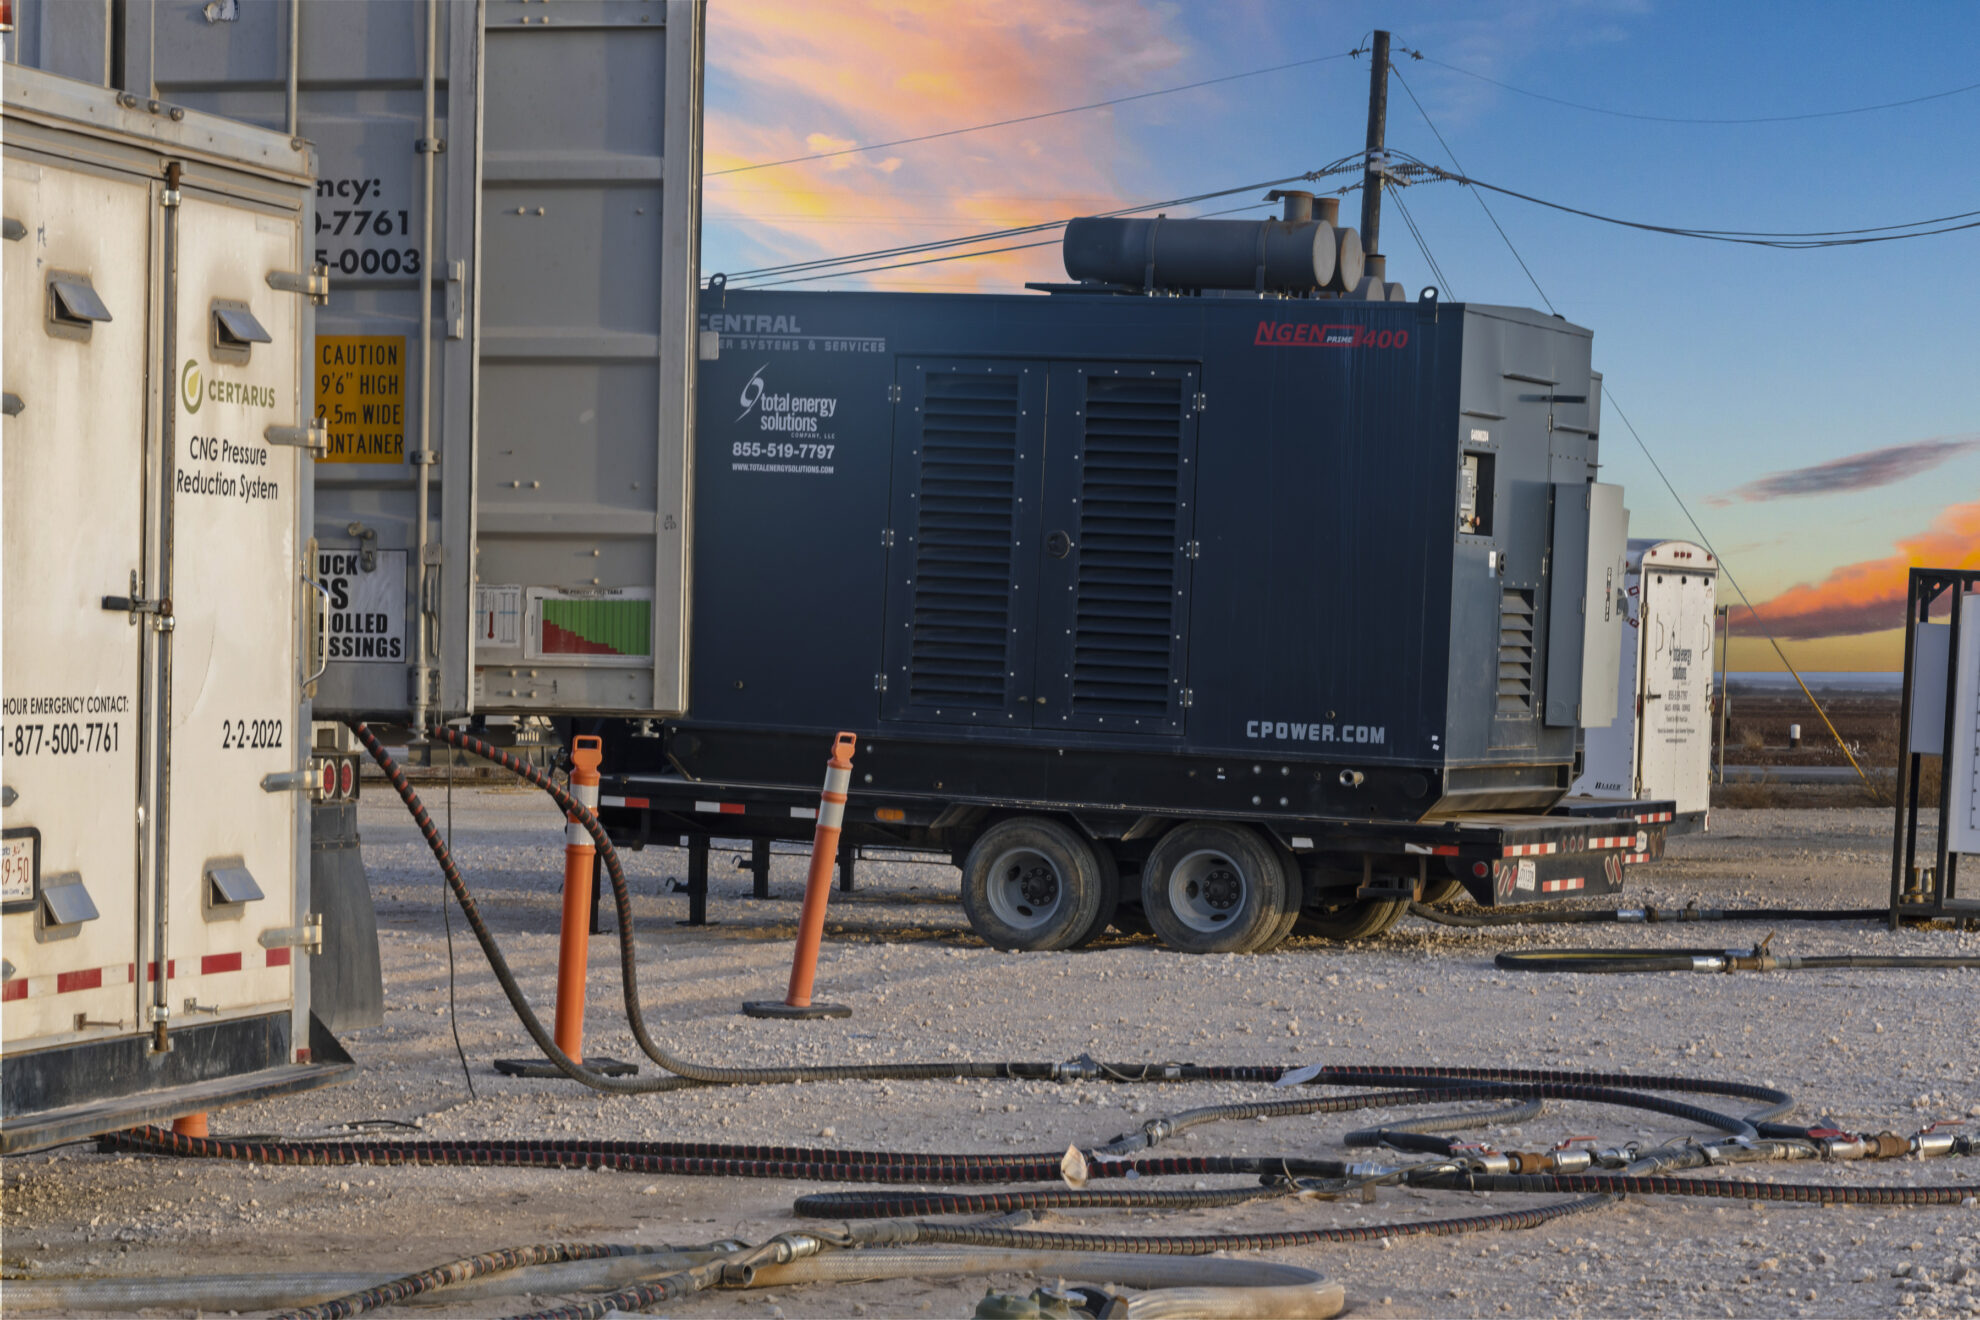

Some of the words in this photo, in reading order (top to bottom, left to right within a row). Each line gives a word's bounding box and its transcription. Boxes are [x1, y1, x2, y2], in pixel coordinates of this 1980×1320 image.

[740, 339, 799, 351] SYSTEMS
[807, 341, 816, 351] &
[824, 341, 885, 353] SERVICES
[1326, 335, 1354, 344] PRIME
[1362, 329, 1409, 349] 400
[322, 344, 398, 366] CAUTION
[208, 379, 276, 409] CERTARUS
[360, 374, 399, 395] HIGH
[317, 404, 357, 425] 2.5m
[363, 404, 401, 425] WIDE
[761, 393, 790, 412] total
[791, 397, 837, 417] energy
[761, 411, 818, 432] solutions
[824, 432, 836, 440] LLC
[190, 435, 219, 462] CNG
[222, 439, 267, 466] Pressure
[732, 441, 836, 459] 855-519-7797
[176, 468, 238, 498] Reduction
[239, 474, 279, 504] System
[2, 697, 28, 716] HOUR
[30, 696, 85, 715] EMERGENCY
[87, 695, 129, 713] CONTACT:
[1, 722, 118, 757] 1-877-500-7761
[222, 718, 283, 749] 2-2-2022
[1246, 720, 1386, 745] CPOWER.COM
